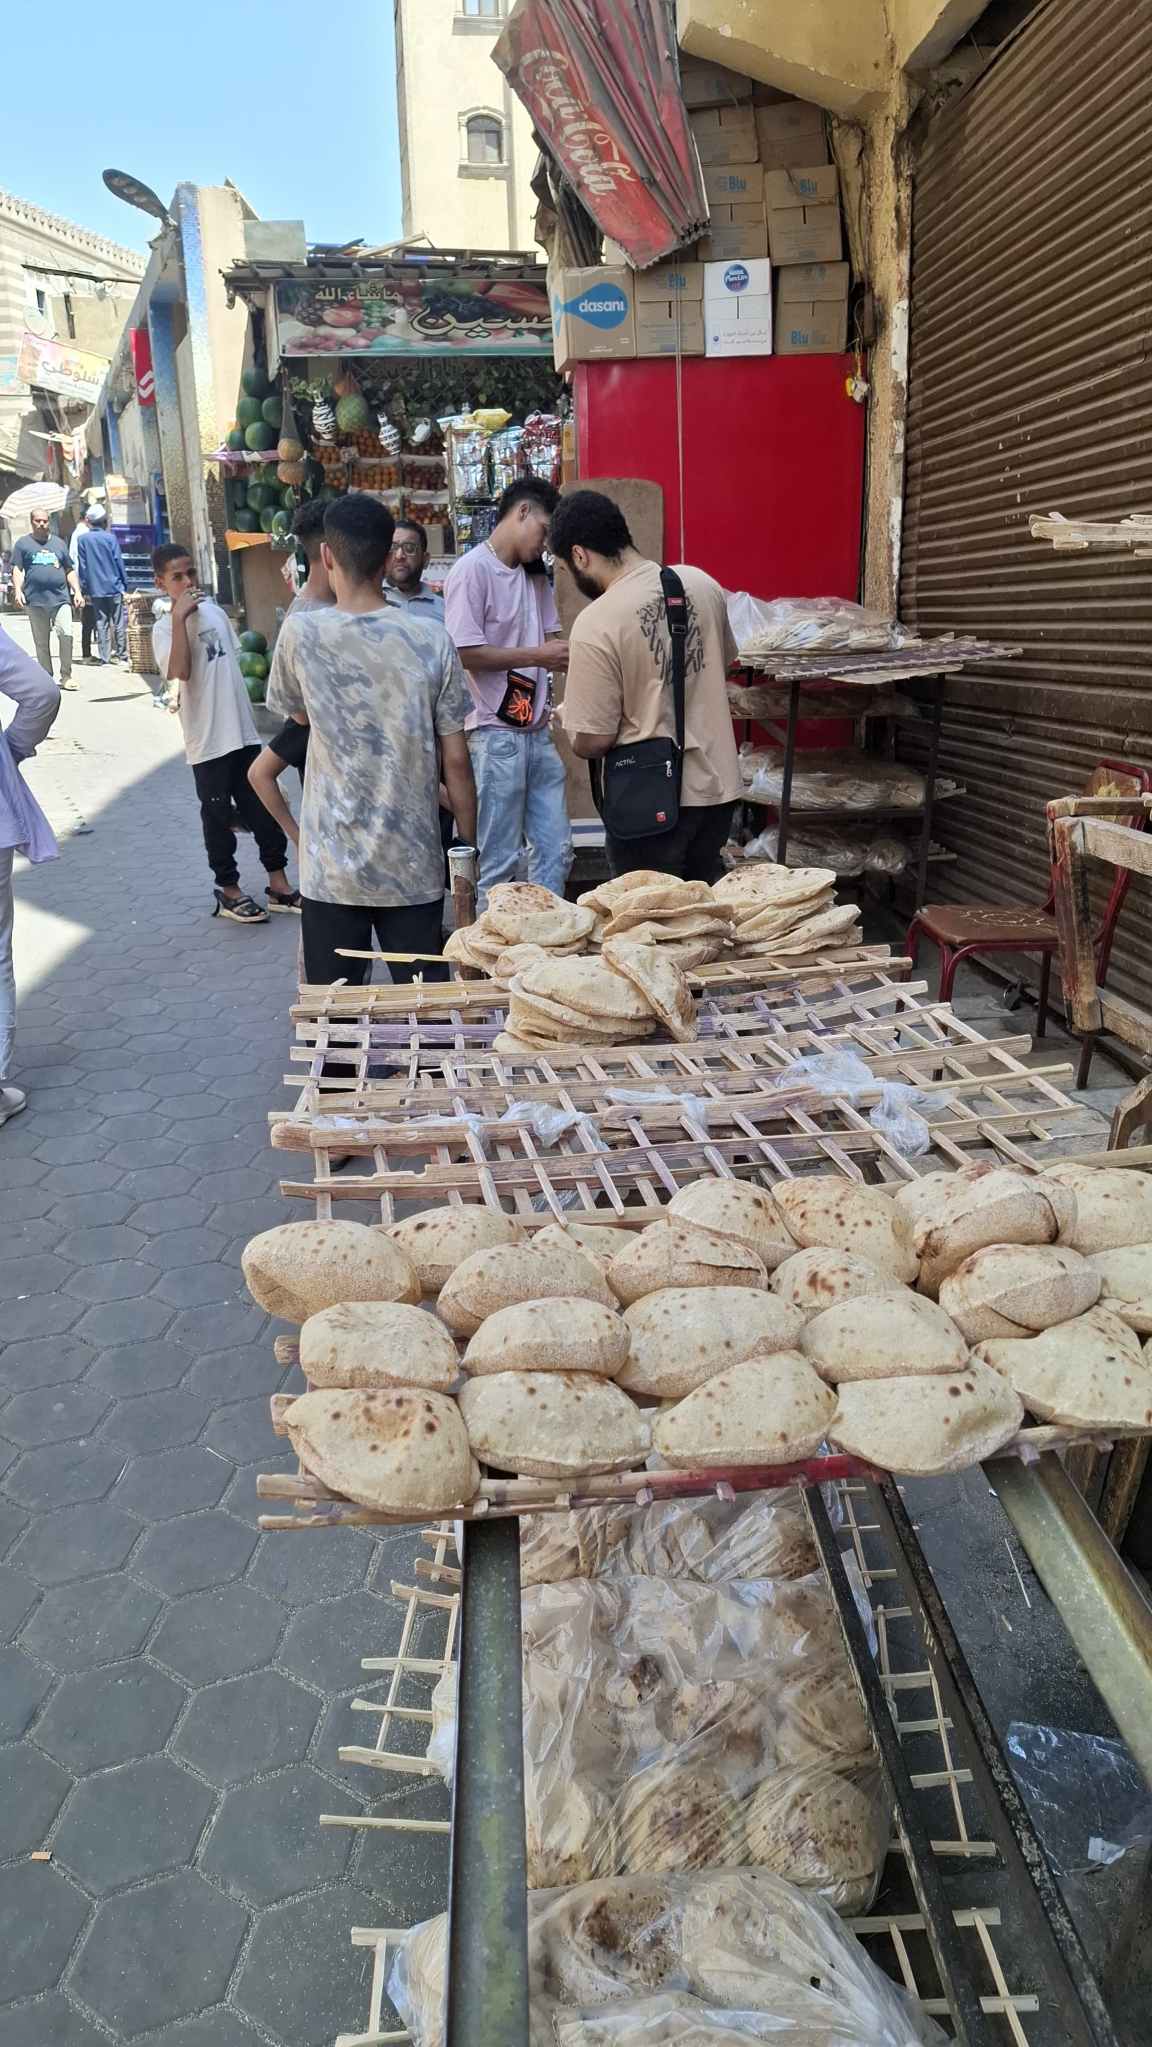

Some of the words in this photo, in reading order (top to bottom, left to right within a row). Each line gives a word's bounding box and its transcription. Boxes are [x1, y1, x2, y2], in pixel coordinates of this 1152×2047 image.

[315, 284, 342, 301] الله
[579, 299, 625, 312] dasani
[791, 331, 809, 344] Blu
